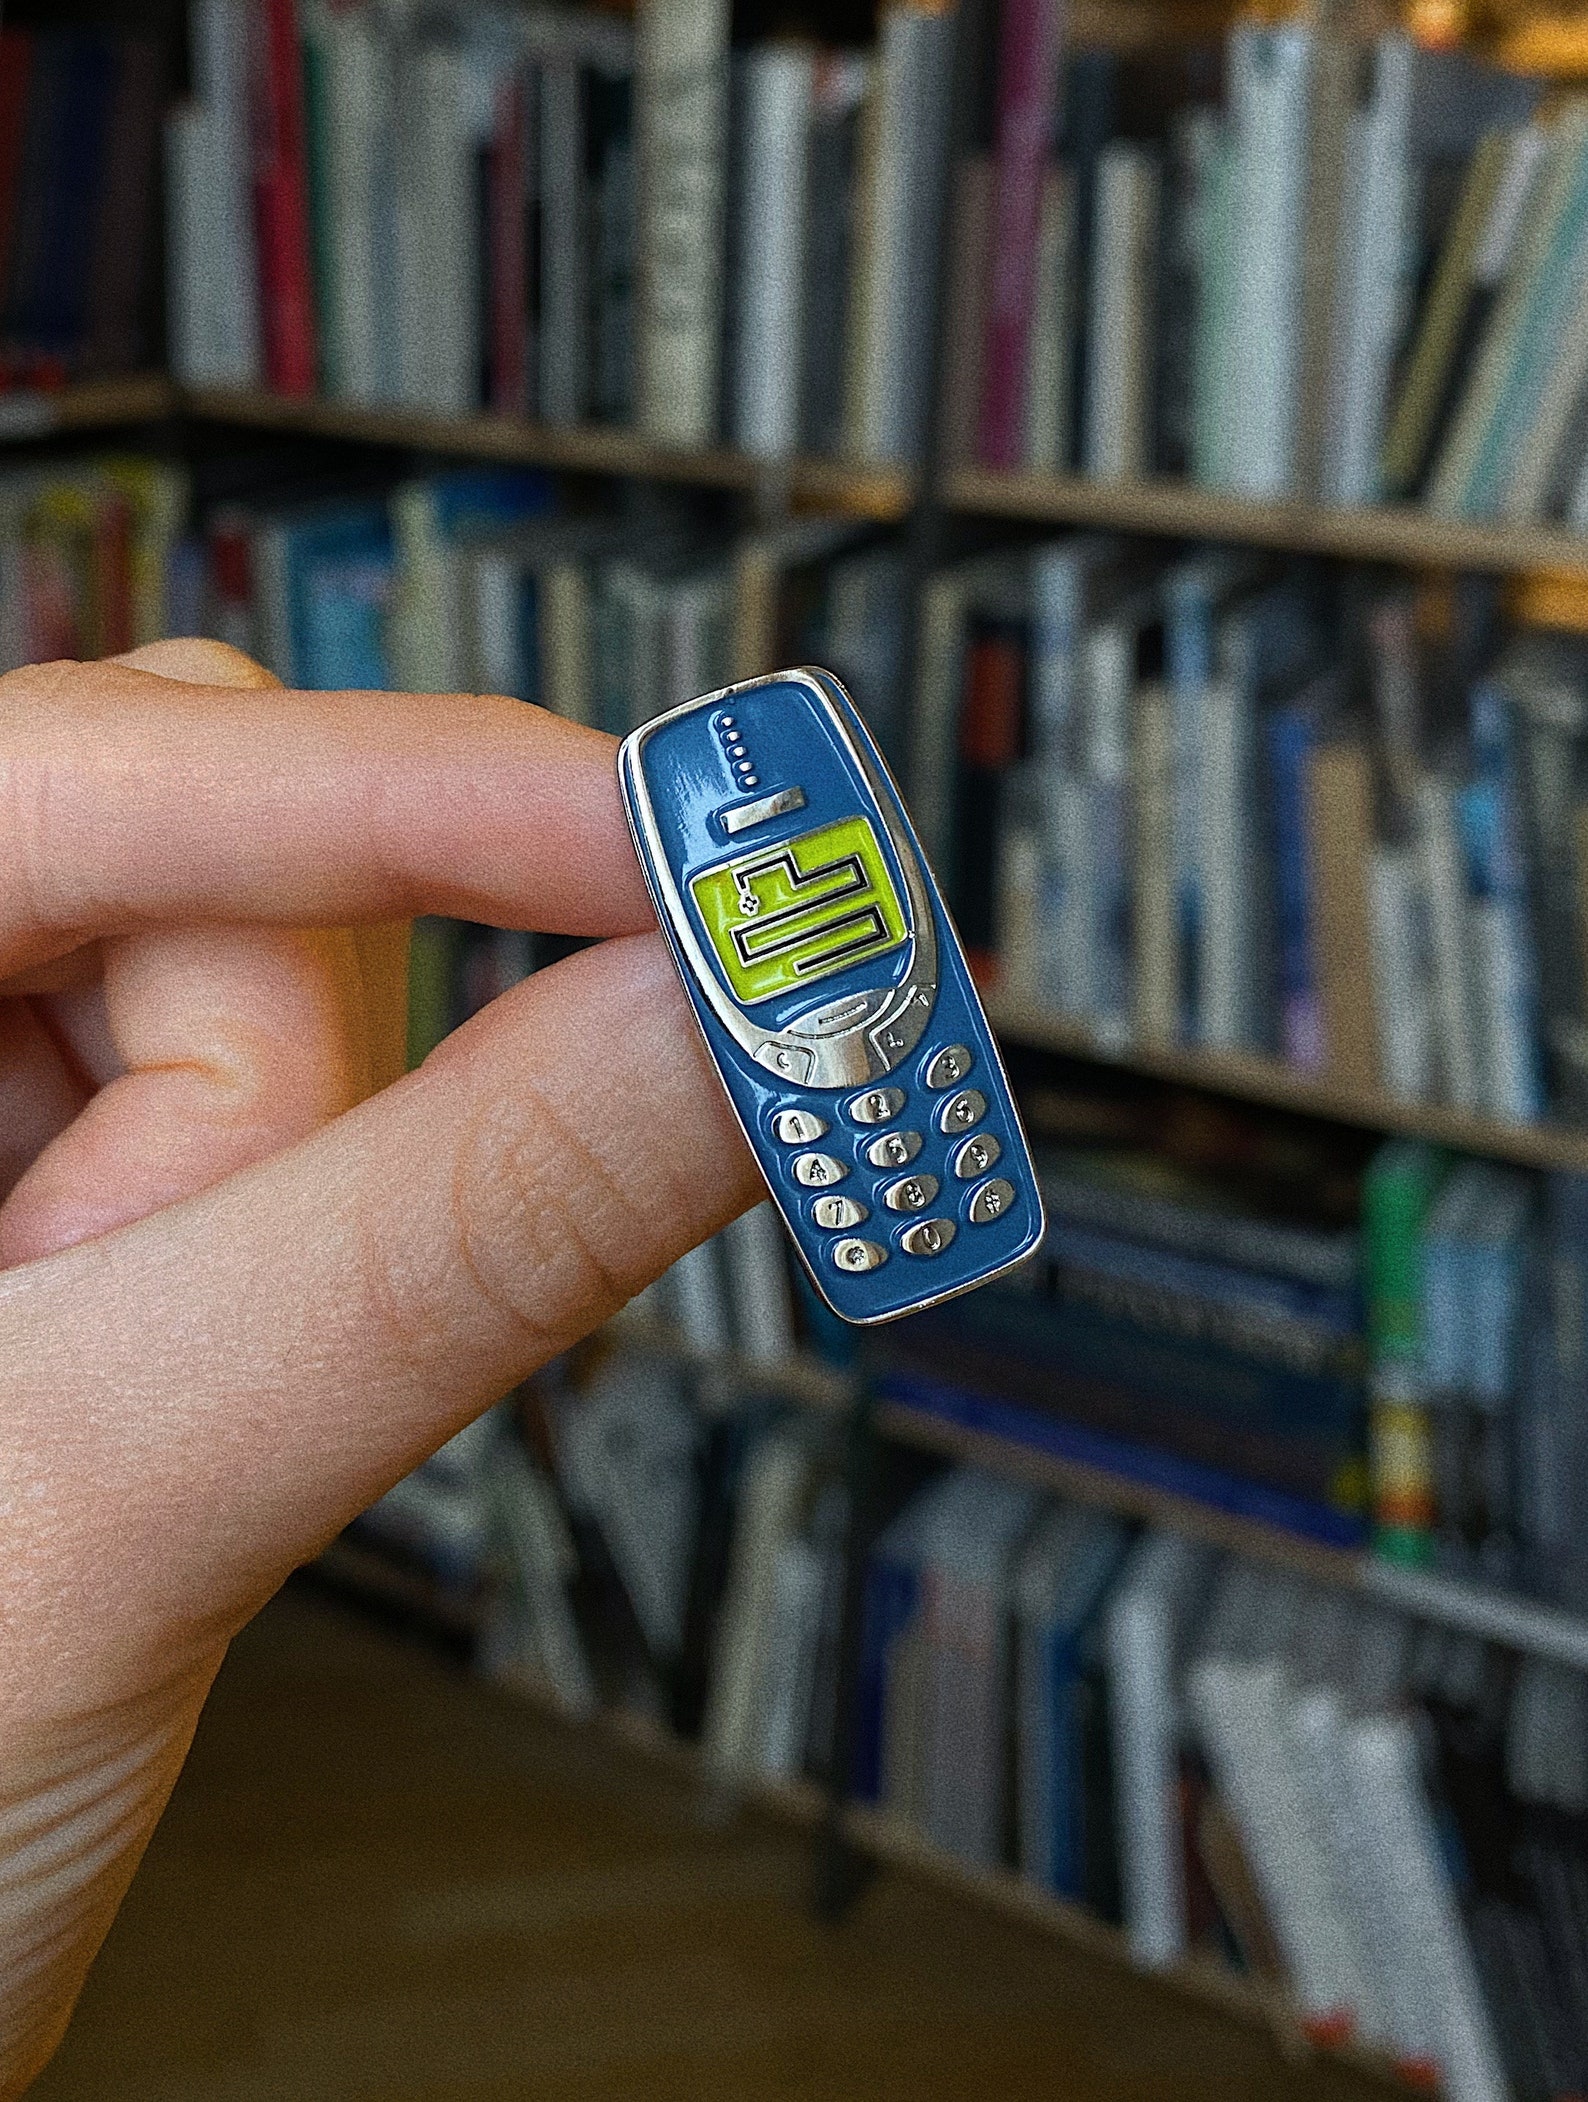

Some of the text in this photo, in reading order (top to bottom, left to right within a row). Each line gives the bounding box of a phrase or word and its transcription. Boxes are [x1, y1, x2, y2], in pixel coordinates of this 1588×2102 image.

[789, 1055, 961, 1139] 1 2 3
[886, 1138, 908, 1164] 5
[956, 1098, 975, 1124] 6
[828, 1144, 989, 1226] 7 8 9
[922, 1226, 942, 1251] 0
